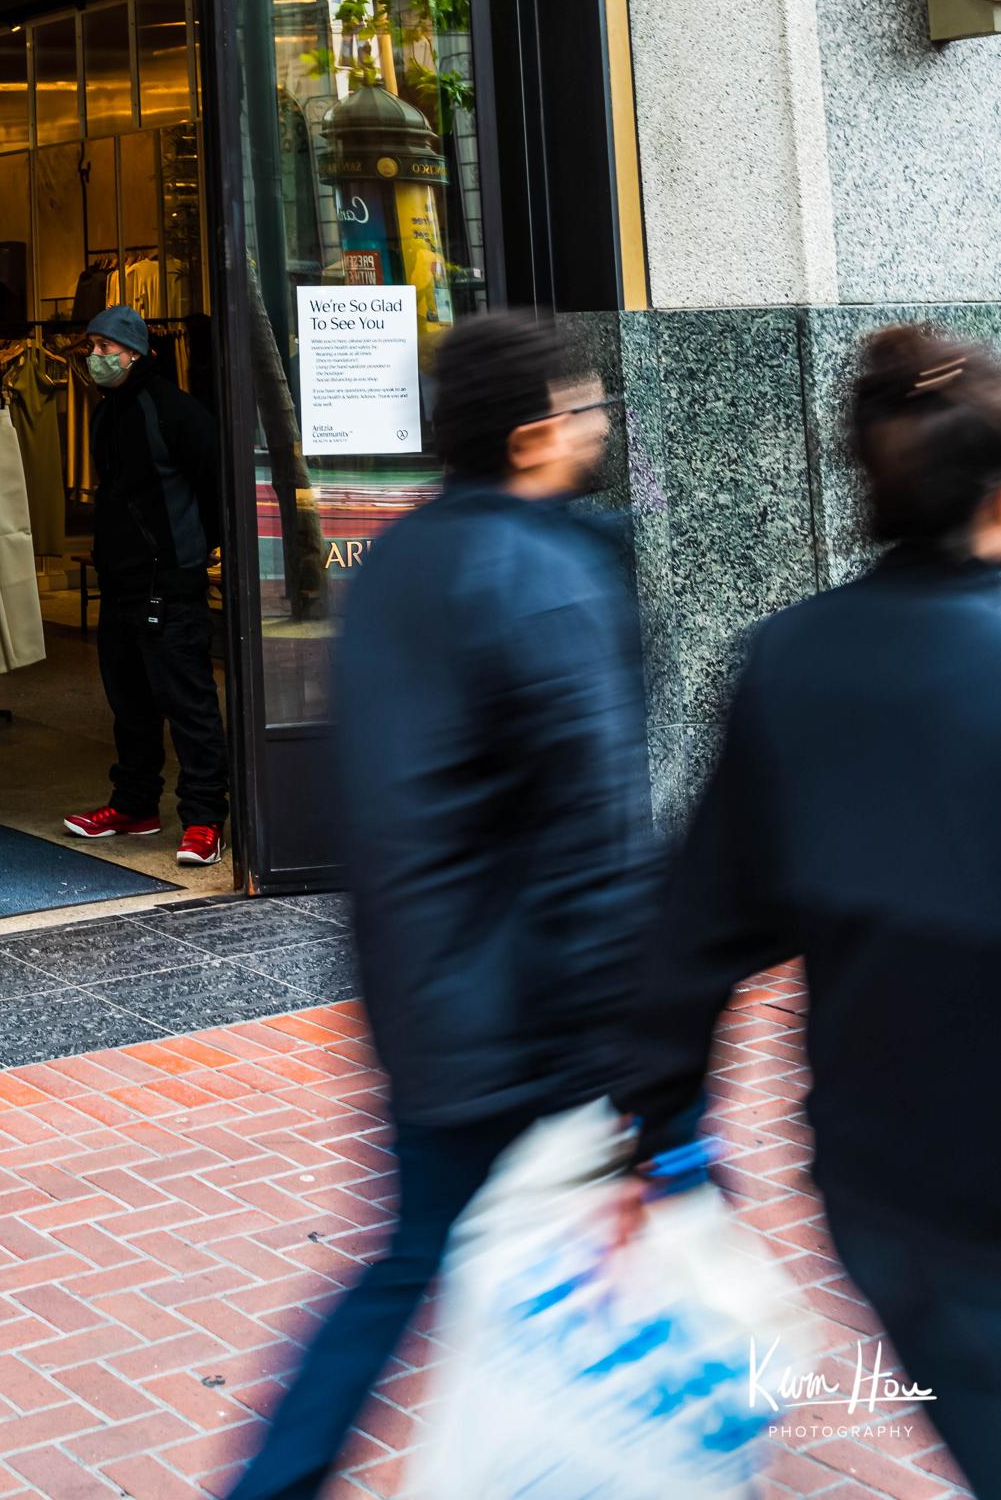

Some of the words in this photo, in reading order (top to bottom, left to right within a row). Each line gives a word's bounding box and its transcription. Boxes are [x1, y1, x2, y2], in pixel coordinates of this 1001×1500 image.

[309, 299, 346, 312] We're
[349, 299, 367, 312] So
[370, 299, 402, 312] Glad
[310, 317, 327, 330] To
[330, 317, 355, 330] See
[359, 316, 384, 330] You
